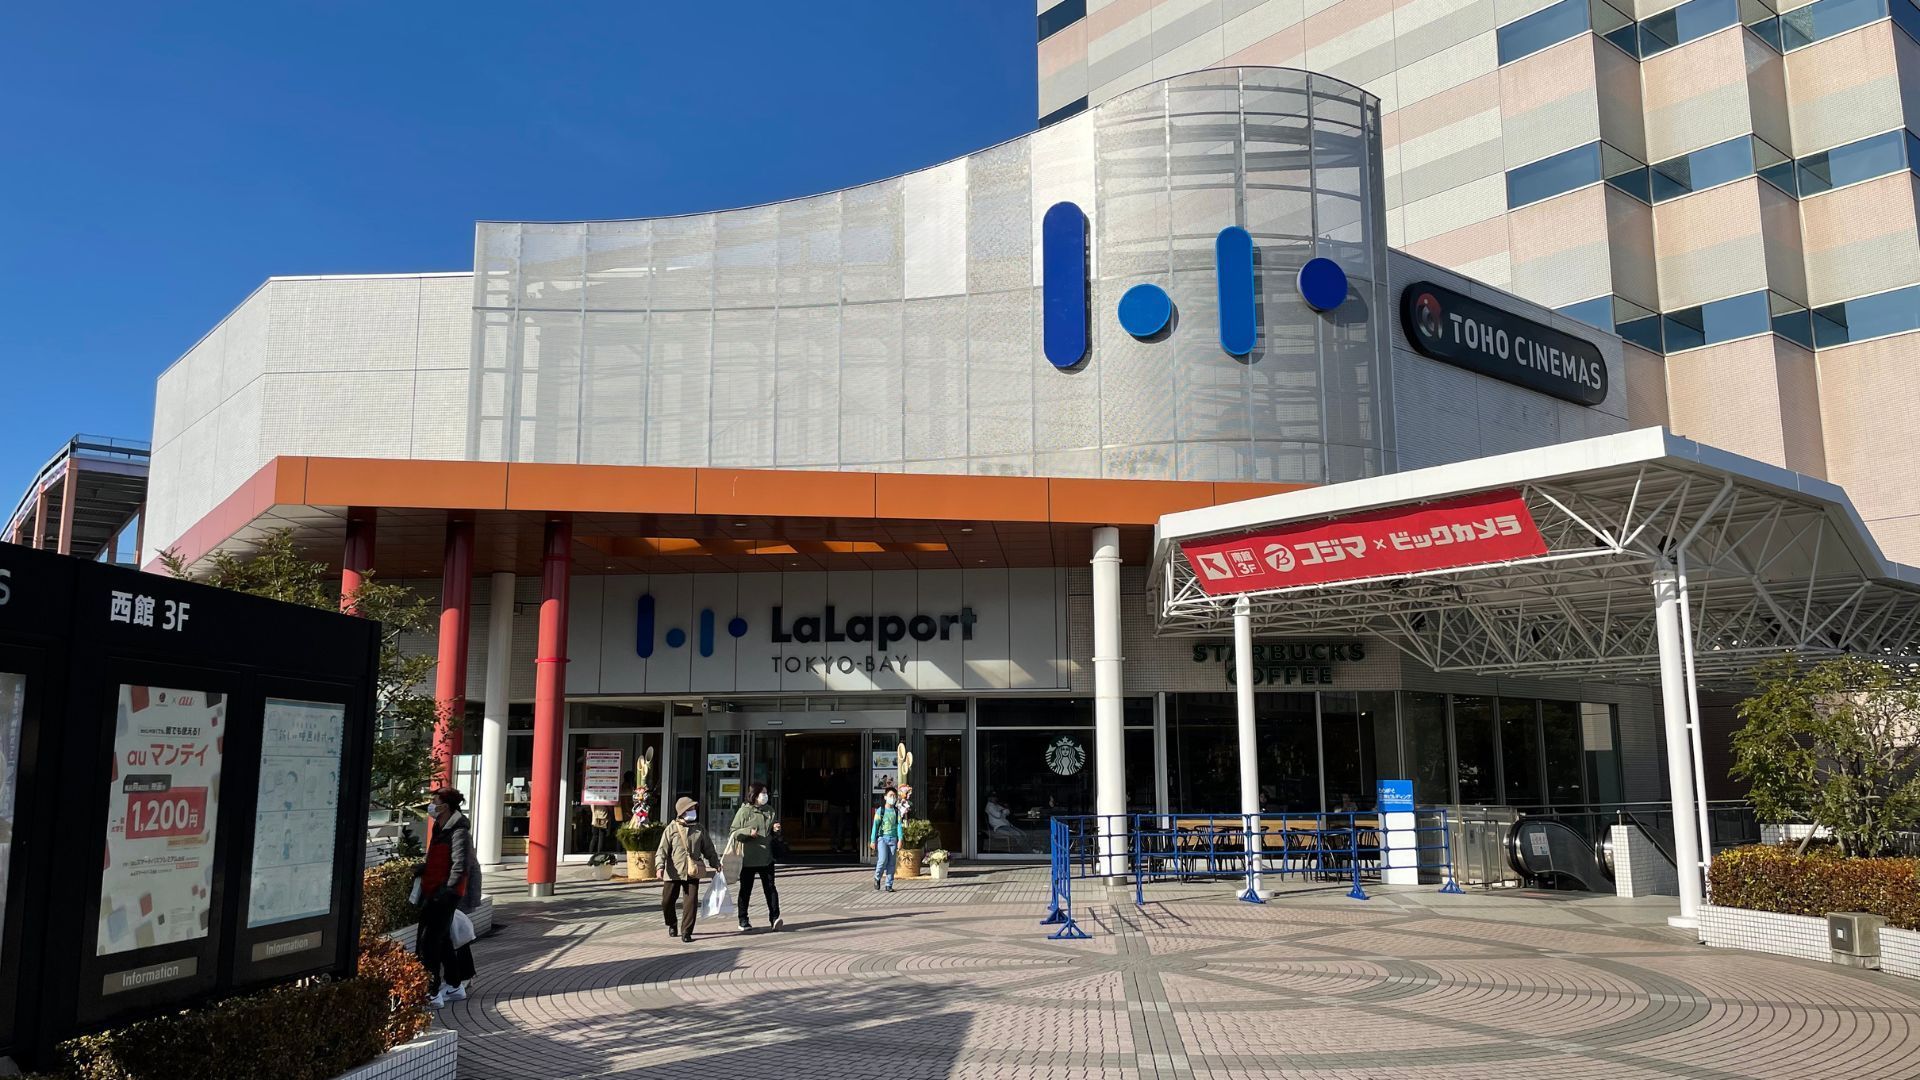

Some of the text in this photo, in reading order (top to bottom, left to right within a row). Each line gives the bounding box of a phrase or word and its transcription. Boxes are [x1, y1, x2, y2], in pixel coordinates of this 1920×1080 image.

[1450, 313, 1602, 390] TOHO CINEMAS
[1294, 536, 1367, 566] コジマ
[1388, 514, 1522, 551] ビックカメラ
[1237, 562, 1257, 575] 3F
[110, 590, 191, 632] 西館 3F
[771, 606, 978, 651] LaLaport
[771, 656, 908, 674] TOKYO-BAY
[178, 696, 194, 706] au
[127, 750, 147, 766] au
[265, 937, 309, 956] Information
[122, 964, 179, 987] Information
